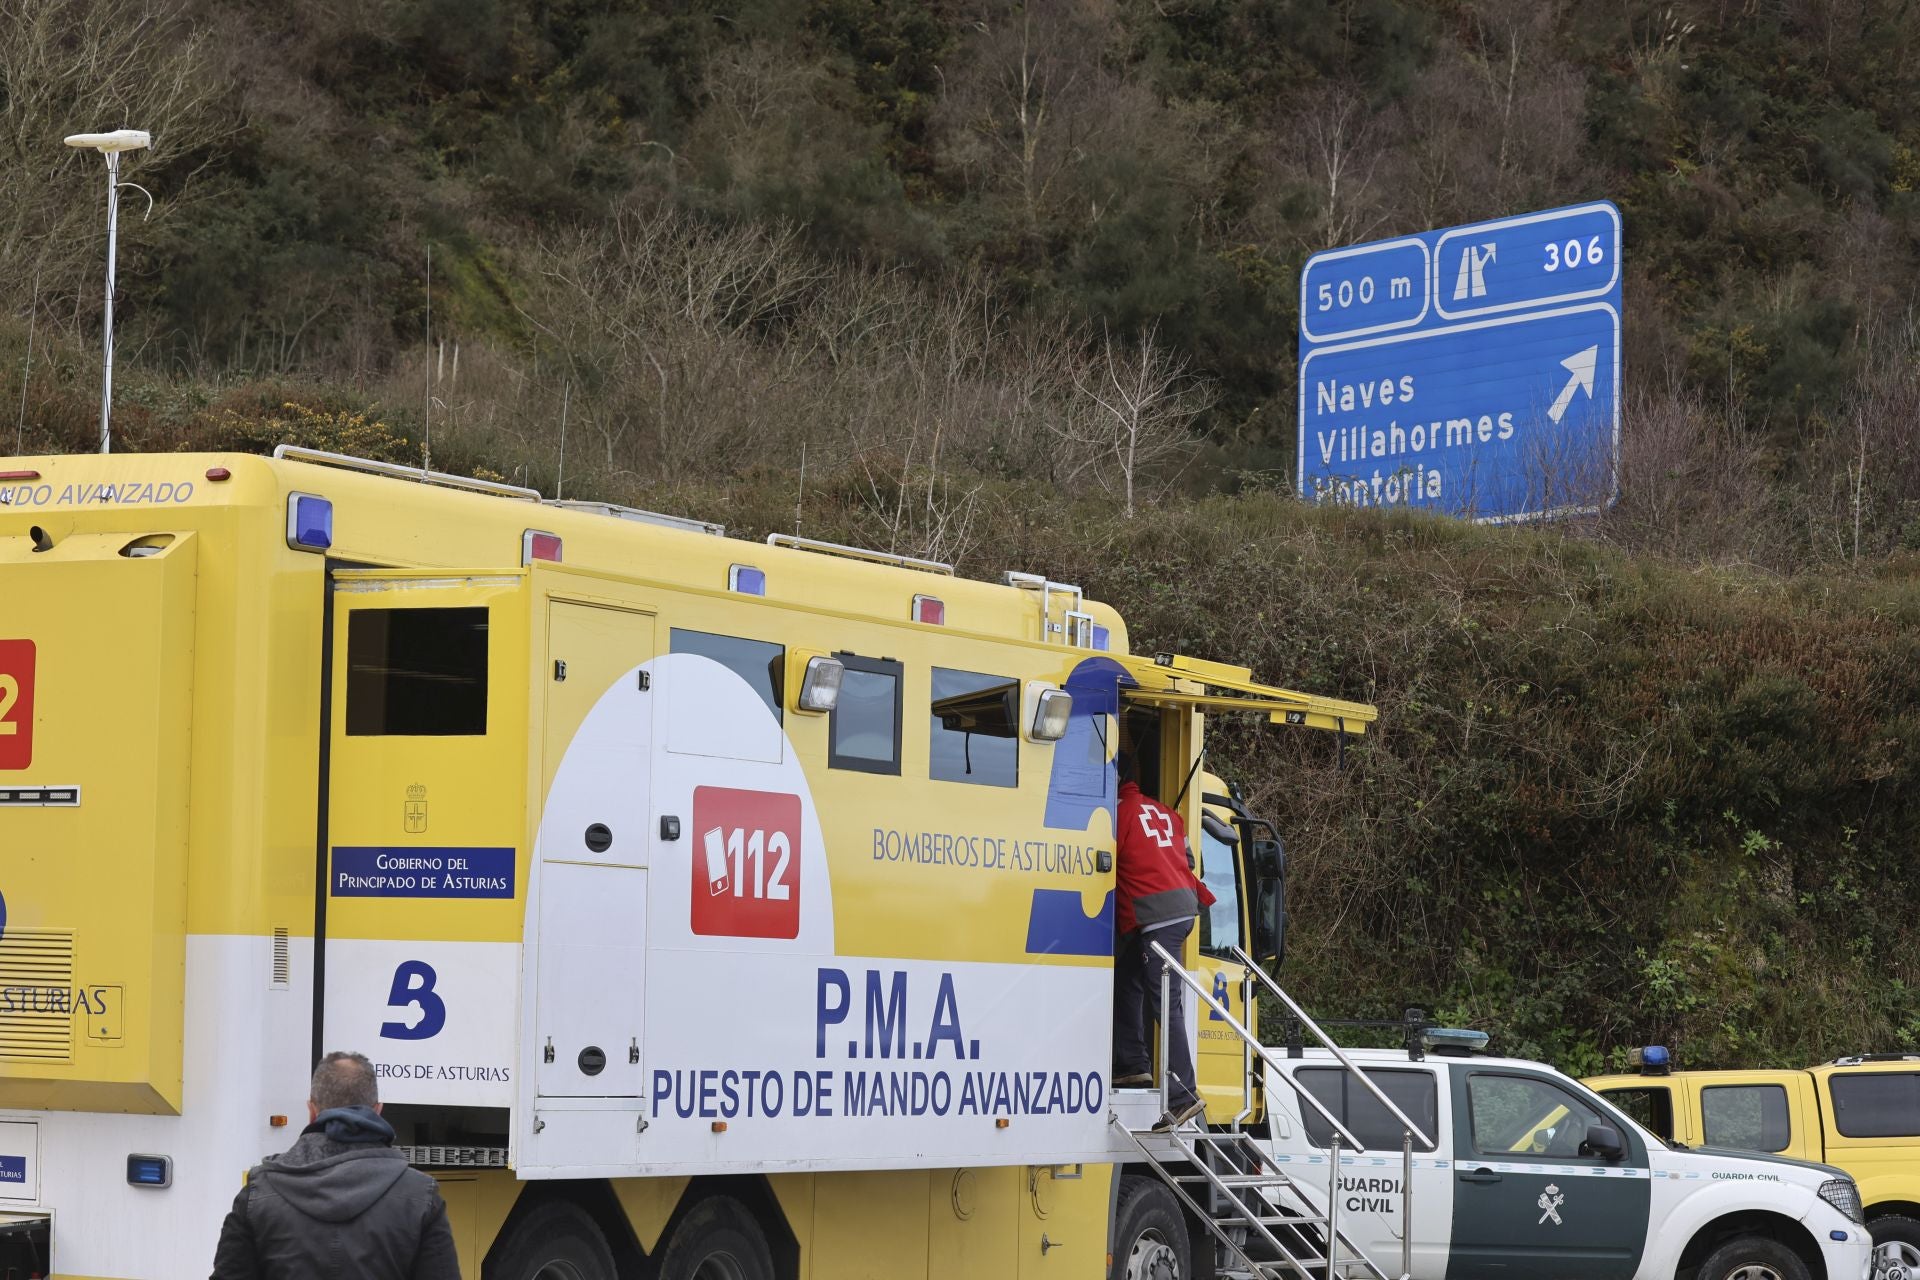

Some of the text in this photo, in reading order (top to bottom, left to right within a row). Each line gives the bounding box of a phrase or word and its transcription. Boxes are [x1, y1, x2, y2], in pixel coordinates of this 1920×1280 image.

[1543, 236, 1605, 273] 306
[1318, 275, 1412, 312] 500 m
[1317, 375, 1415, 415] Naves
[1317, 412, 1514, 465] Villahormes
[57, 482, 194, 505] AVANZADO
[727, 827, 791, 901] 112
[873, 828, 1094, 876] BOMBEROS DE ASTURIAS
[0, 987, 107, 1015] STURIAS
[816, 967, 980, 1060] P.M.A.
[375, 1063, 510, 1082] EROS DE ASTURIAS
[652, 1069, 1103, 1119] PUESTO DE MANDO AVANZADO
[1711, 1172, 1781, 1182] GUARDIA CIVIL
[1346, 1197, 1394, 1213] CIVIL
